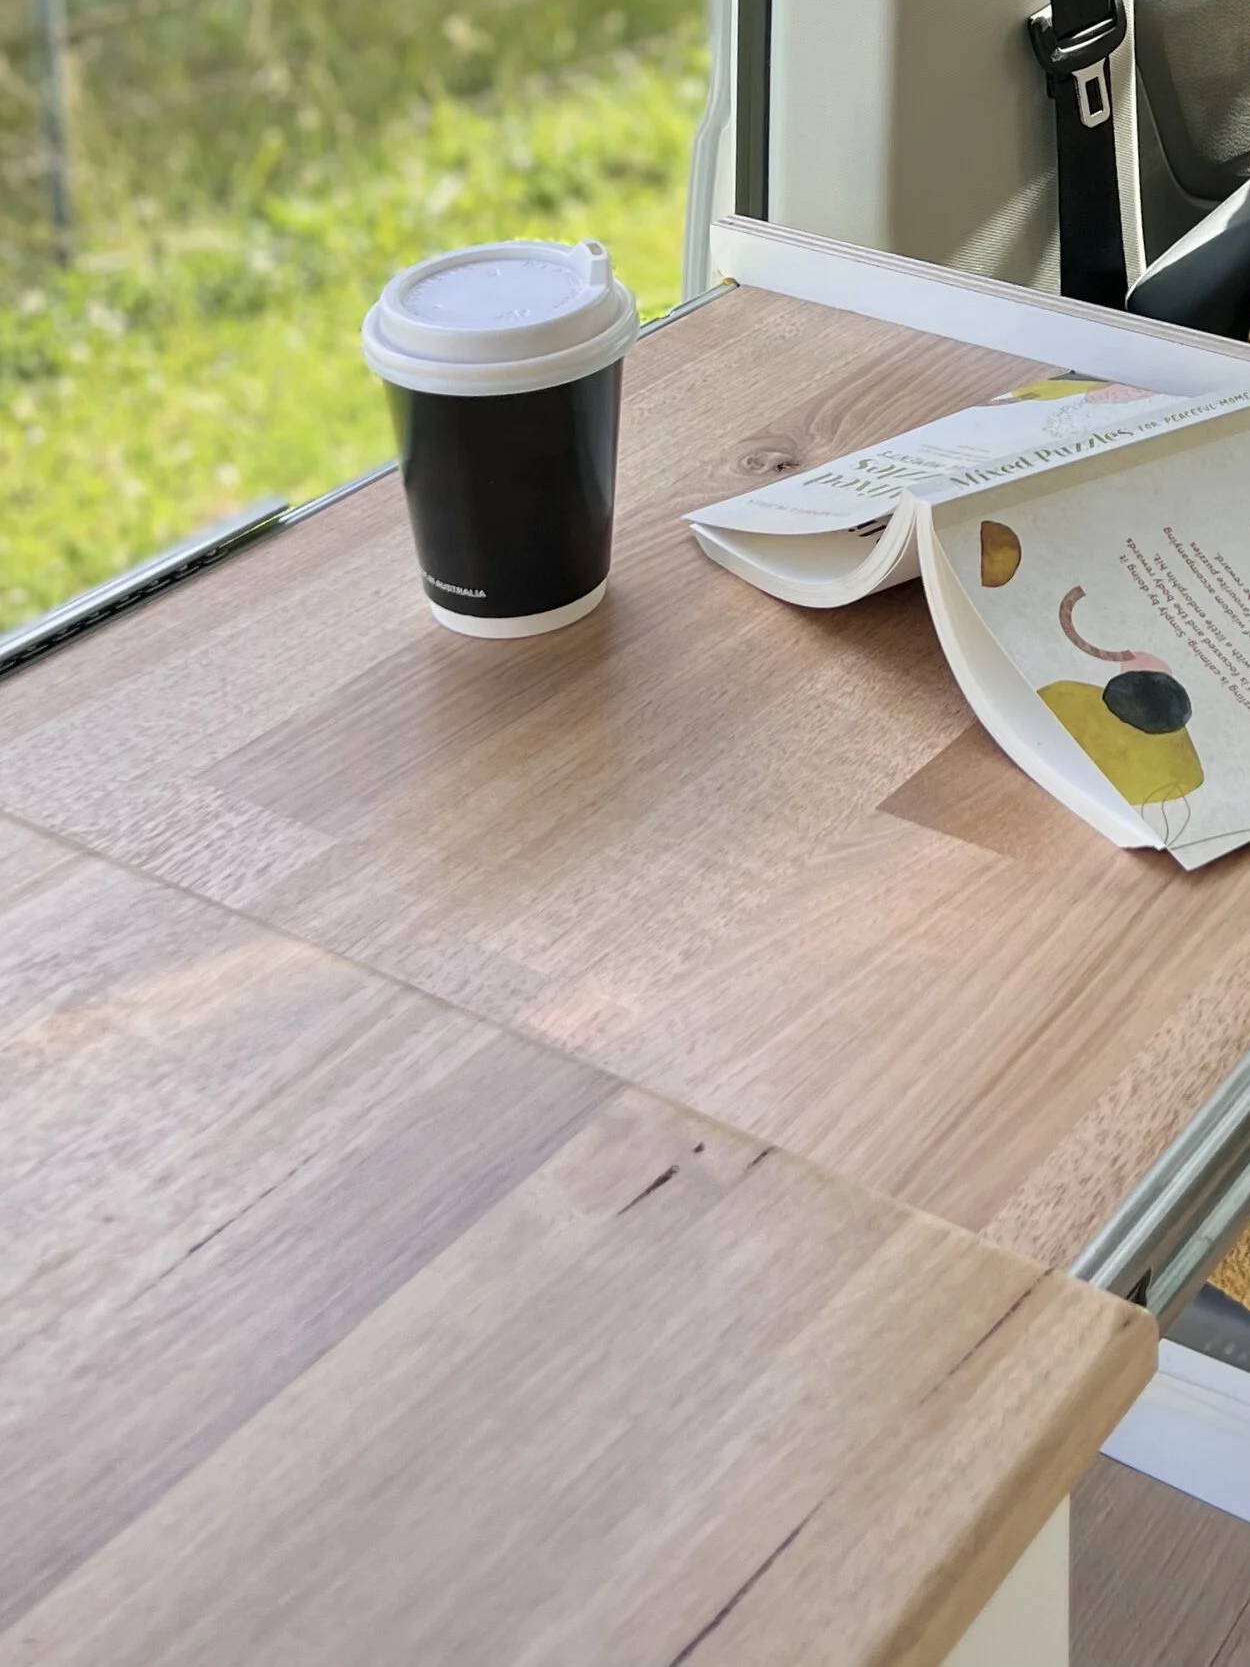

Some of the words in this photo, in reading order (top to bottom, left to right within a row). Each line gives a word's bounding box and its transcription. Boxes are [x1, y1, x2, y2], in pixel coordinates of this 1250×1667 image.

[949, 456, 1034, 490] Mixed
[1034, 429, 1134, 462] Puzzles
[1138, 421, 1157, 433] FOR
[1164, 404, 1216, 425] PEACEFUL
[1118, 553, 1128, 564] it
[1124, 537, 1157, 577] rewards
[1152, 552, 1168, 571] hit.
[1160, 525, 1222, 595] accompanying
[1188, 541, 1220, 577] puzzles
[1212, 551, 1245, 587] reward.
[435, 579, 487, 598] AUSTRALIA
[1124, 563, 1151, 593] doing
[1152, 577, 1176, 603] body
[1146, 592, 1160, 607] by
[1164, 569, 1208, 619] endorphin
[1156, 605, 1187, 639] Simply
[1172, 601, 1188, 620] the
[1214, 594, 1246, 629] wisdom
[1185, 619, 1204, 637] and
[1204, 618, 1226, 642] little
[1186, 637, 1222, 677] calming.
[1201, 636, 1241, 677] focussed
[1219, 675, 1230, 685] is
[1238, 676, 1250, 687] is
